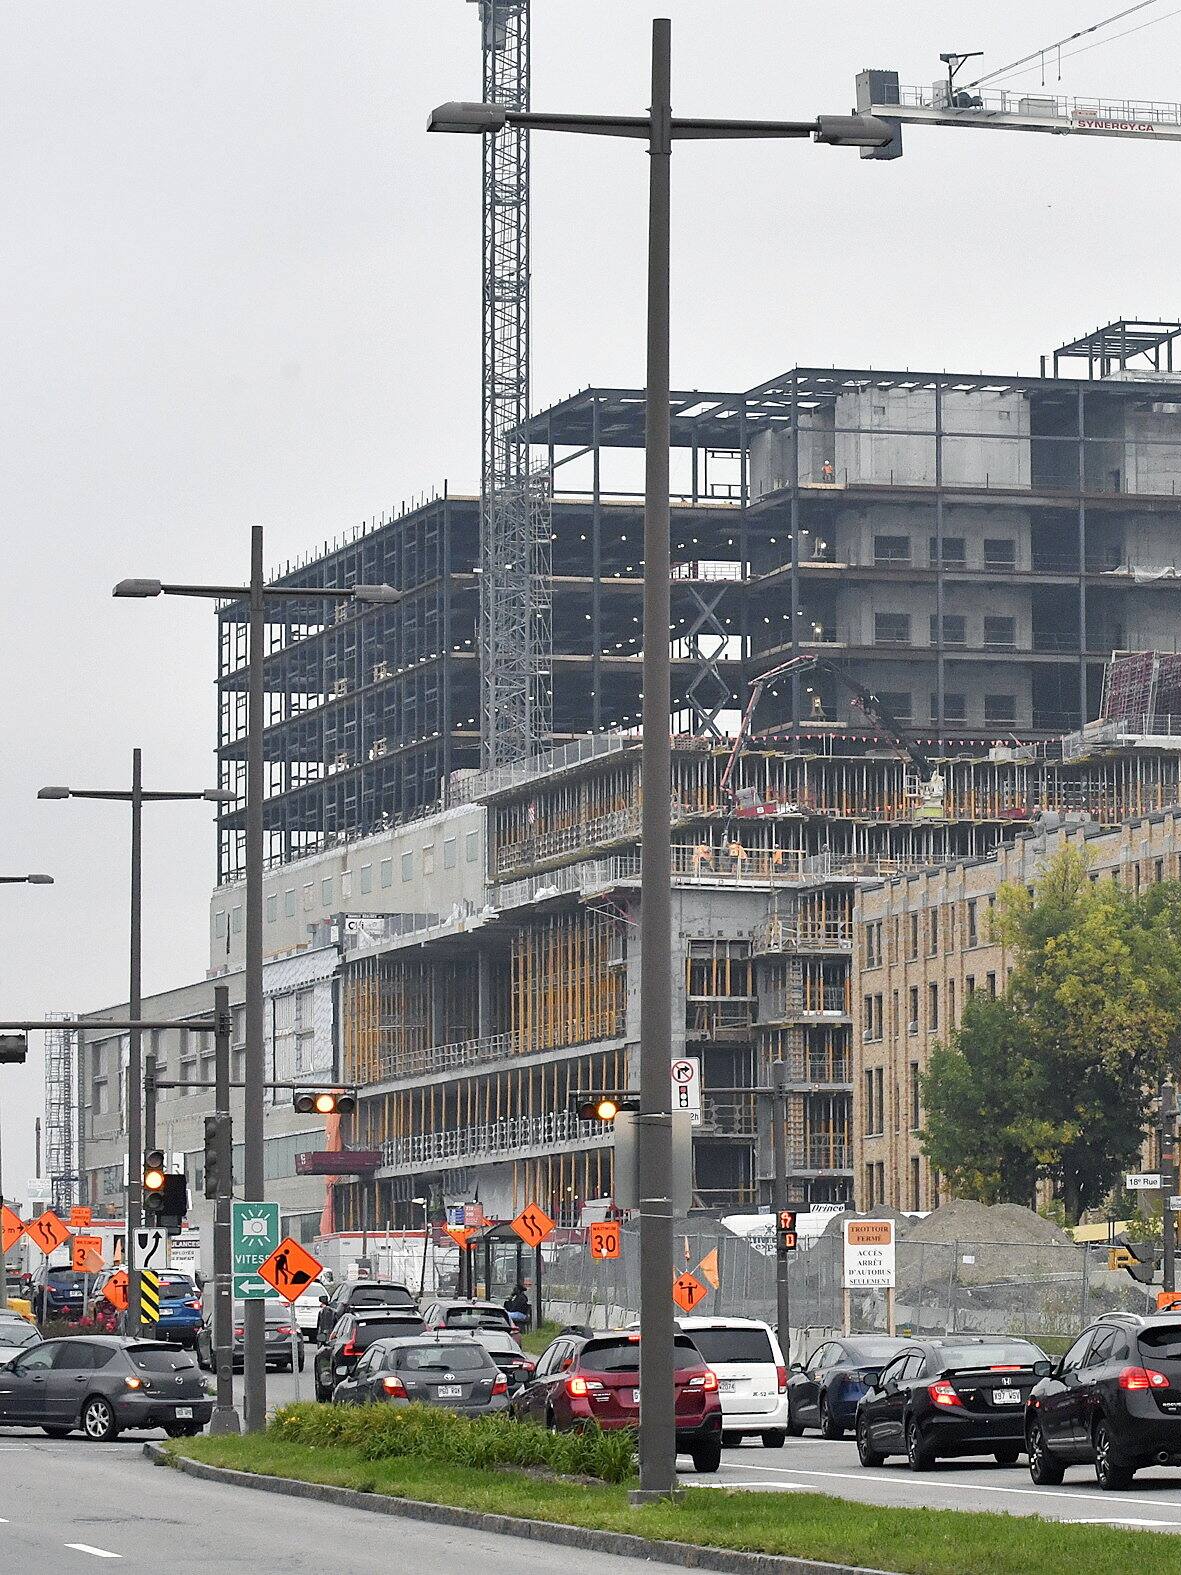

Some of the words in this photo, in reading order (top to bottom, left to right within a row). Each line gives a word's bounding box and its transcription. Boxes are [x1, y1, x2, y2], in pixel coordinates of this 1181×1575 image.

[1078, 120, 1155, 132] SYNERGY.CA
[1142, 1178, 1158, 1186] Rue
[171, 1240, 200, 1248] ULANCES
[594, 1234, 616, 1253] 30
